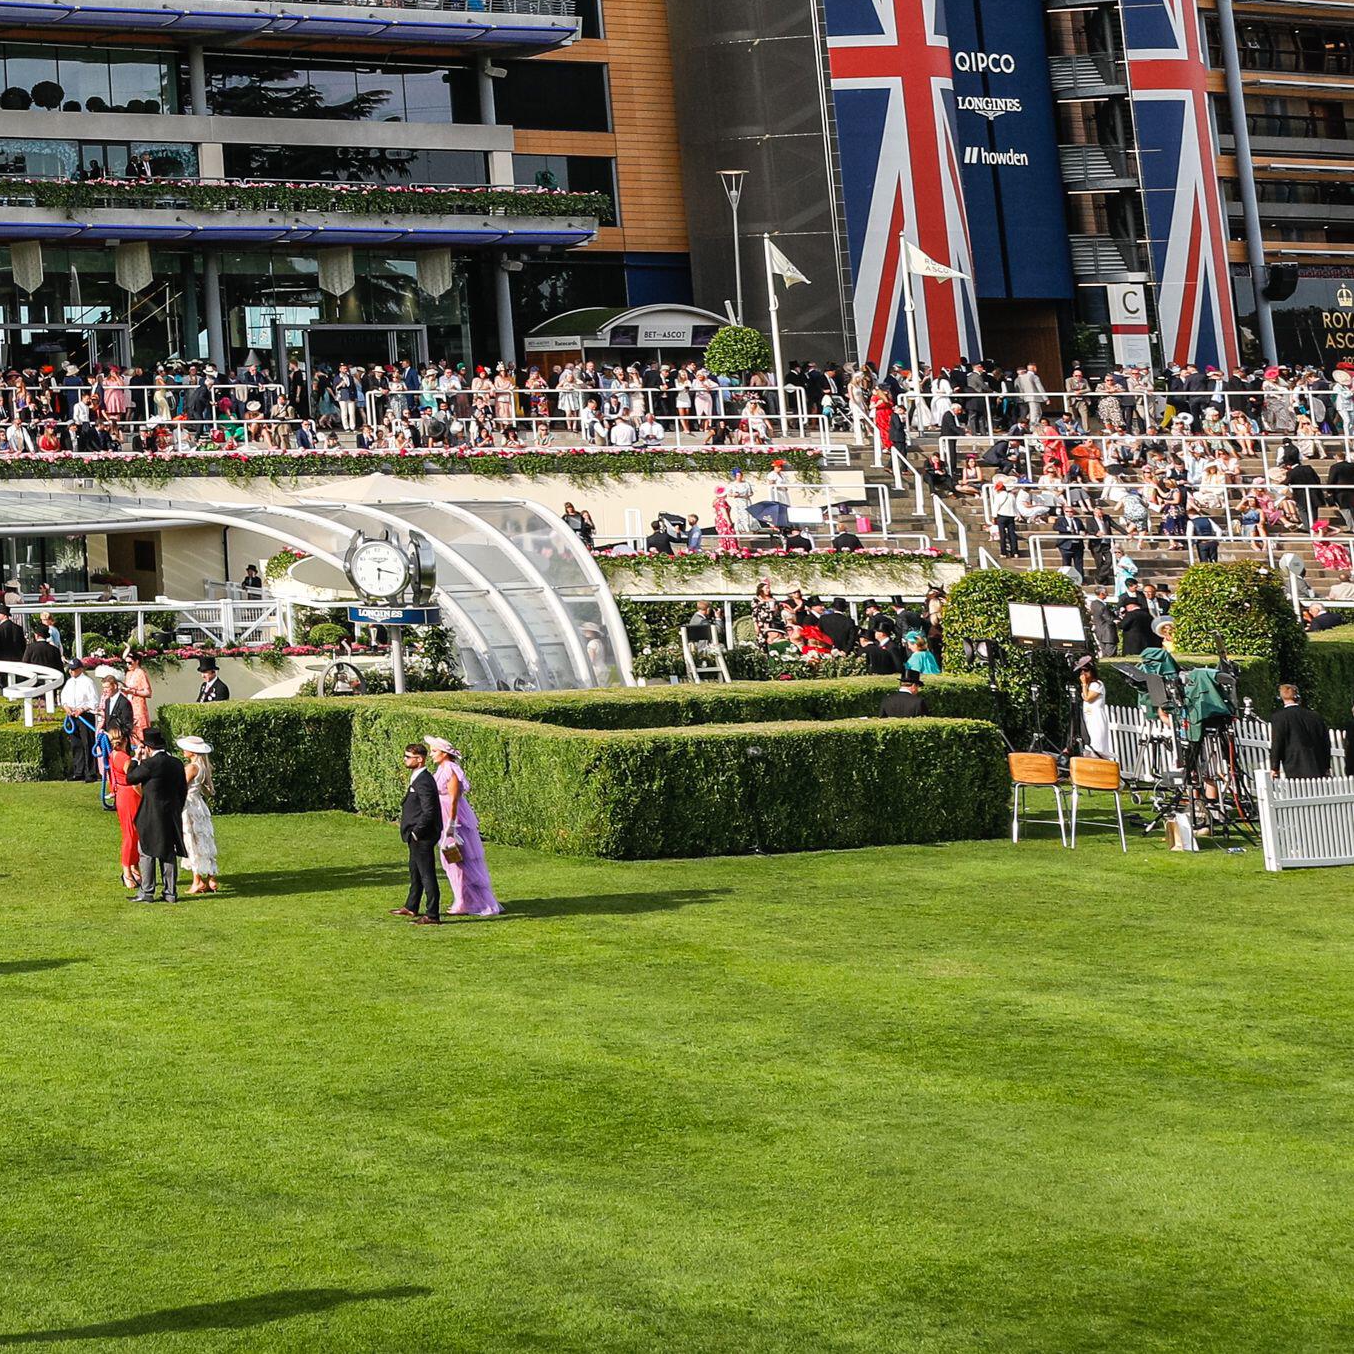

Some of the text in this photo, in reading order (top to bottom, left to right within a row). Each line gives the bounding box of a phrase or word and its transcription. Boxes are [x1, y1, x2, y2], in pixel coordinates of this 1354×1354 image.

[954, 51, 1015, 74] QIPCO
[957, 96, 1022, 112] LONGINES
[981, 147, 1028, 166] howden
[1122, 291, 1140, 314] C
[1322, 312, 1354, 328] ROY
[358, 608, 403, 618] LONGINES
